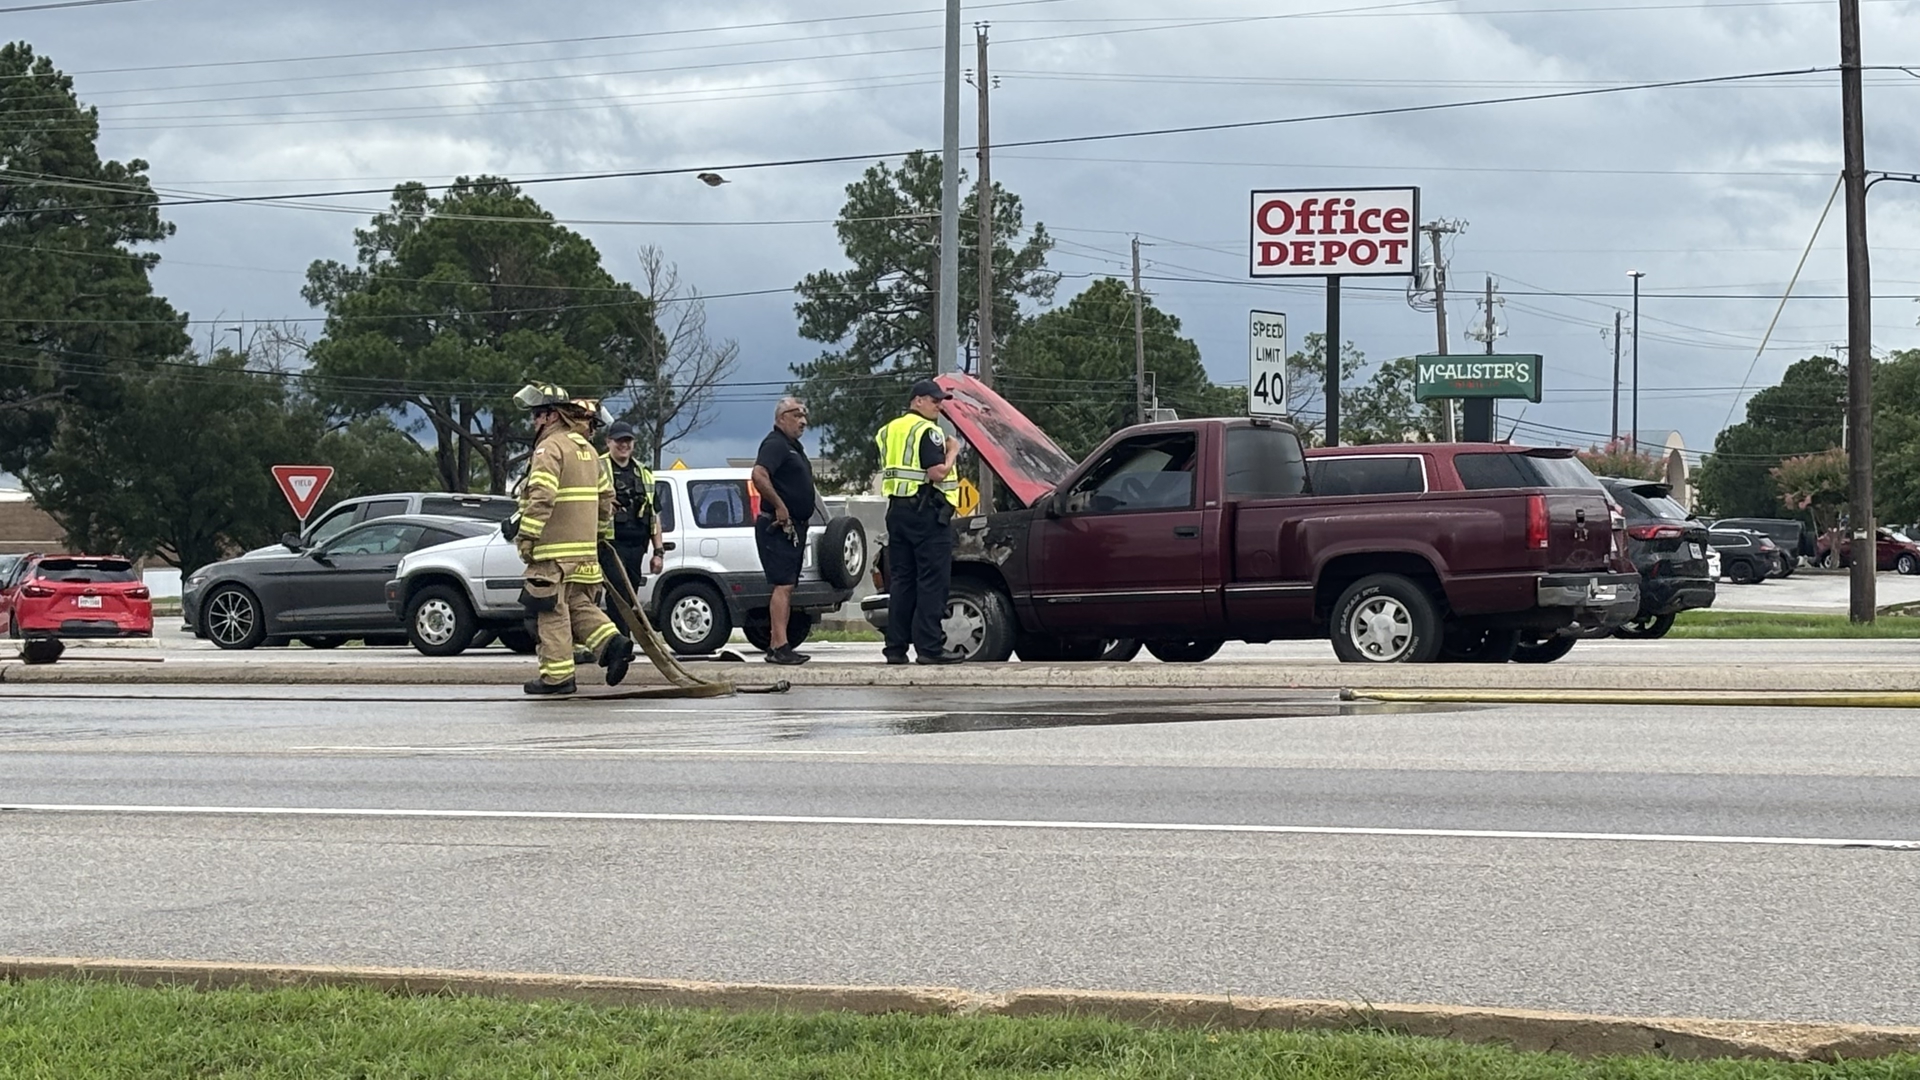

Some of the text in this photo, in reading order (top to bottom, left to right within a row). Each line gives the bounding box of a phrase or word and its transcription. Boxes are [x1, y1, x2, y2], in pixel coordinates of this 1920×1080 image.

[1257, 198, 1410, 236] Office
[1257, 239, 1409, 267] DEPOT
[1252, 321, 1284, 339] SPEED
[1256, 346, 1281, 363] LIMIT
[1253, 371, 1284, 406] 40
[294, 479, 313, 487] YIELD
